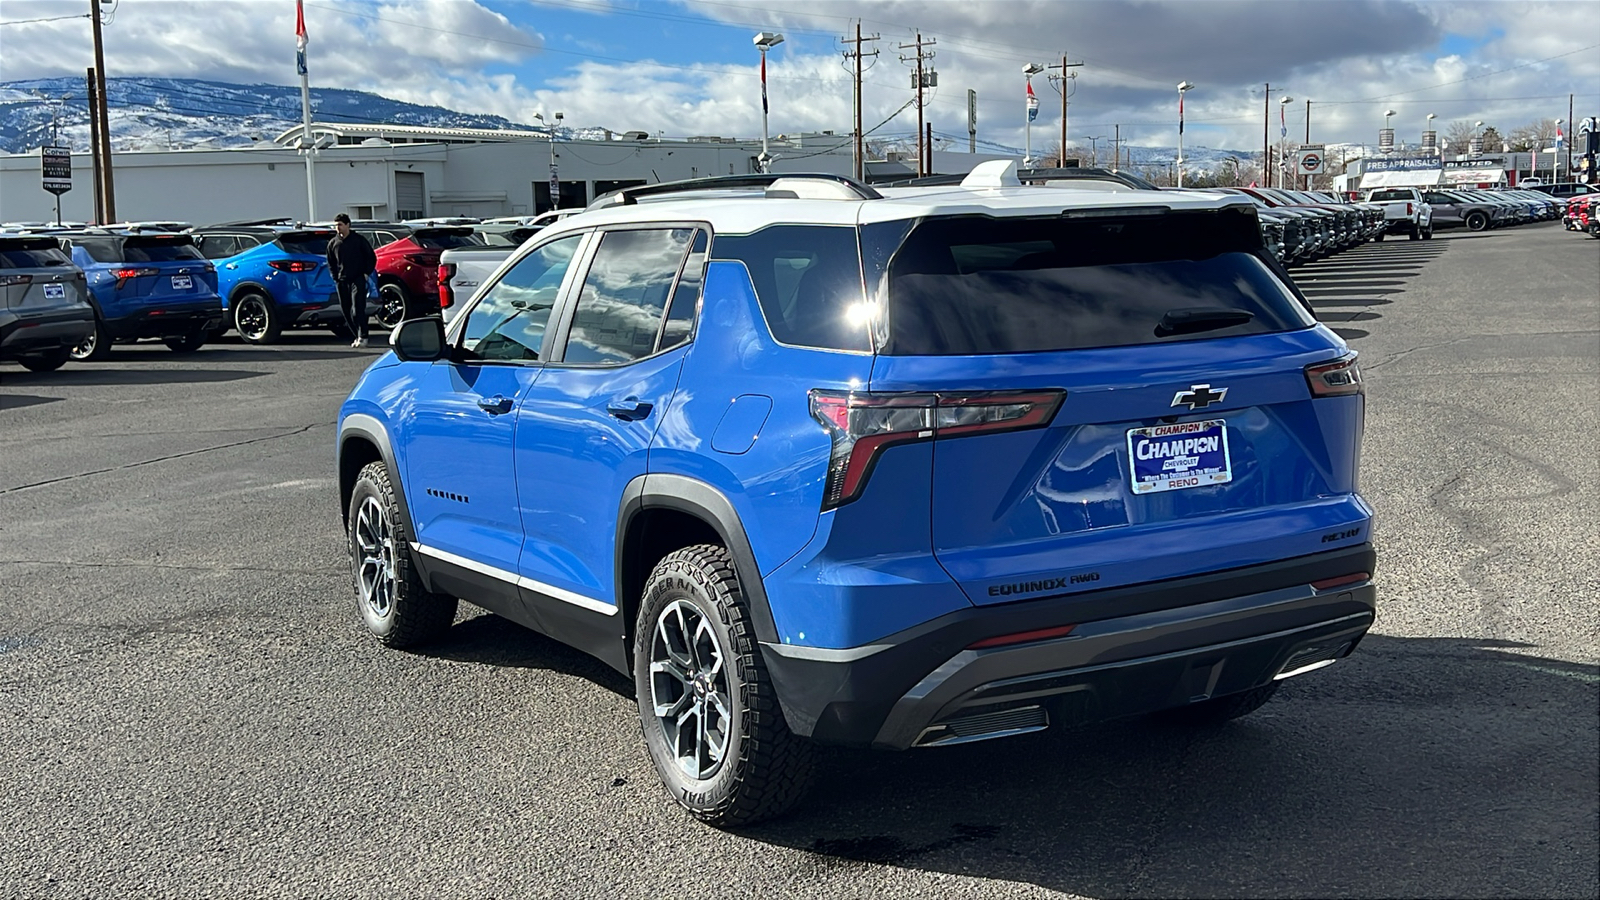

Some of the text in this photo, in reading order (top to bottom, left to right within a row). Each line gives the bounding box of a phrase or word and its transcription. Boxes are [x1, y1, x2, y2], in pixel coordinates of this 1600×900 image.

[1367, 159, 1440, 170] FREE APPRAISALS!
[1155, 423, 1200, 436] CHAMPION
[1136, 436, 1219, 460] CHAMPION
[1164, 458, 1197, 468] CHEVROLET
[1169, 477, 1199, 488] RENO
[988, 572, 1100, 597] EQUINOX AWD
